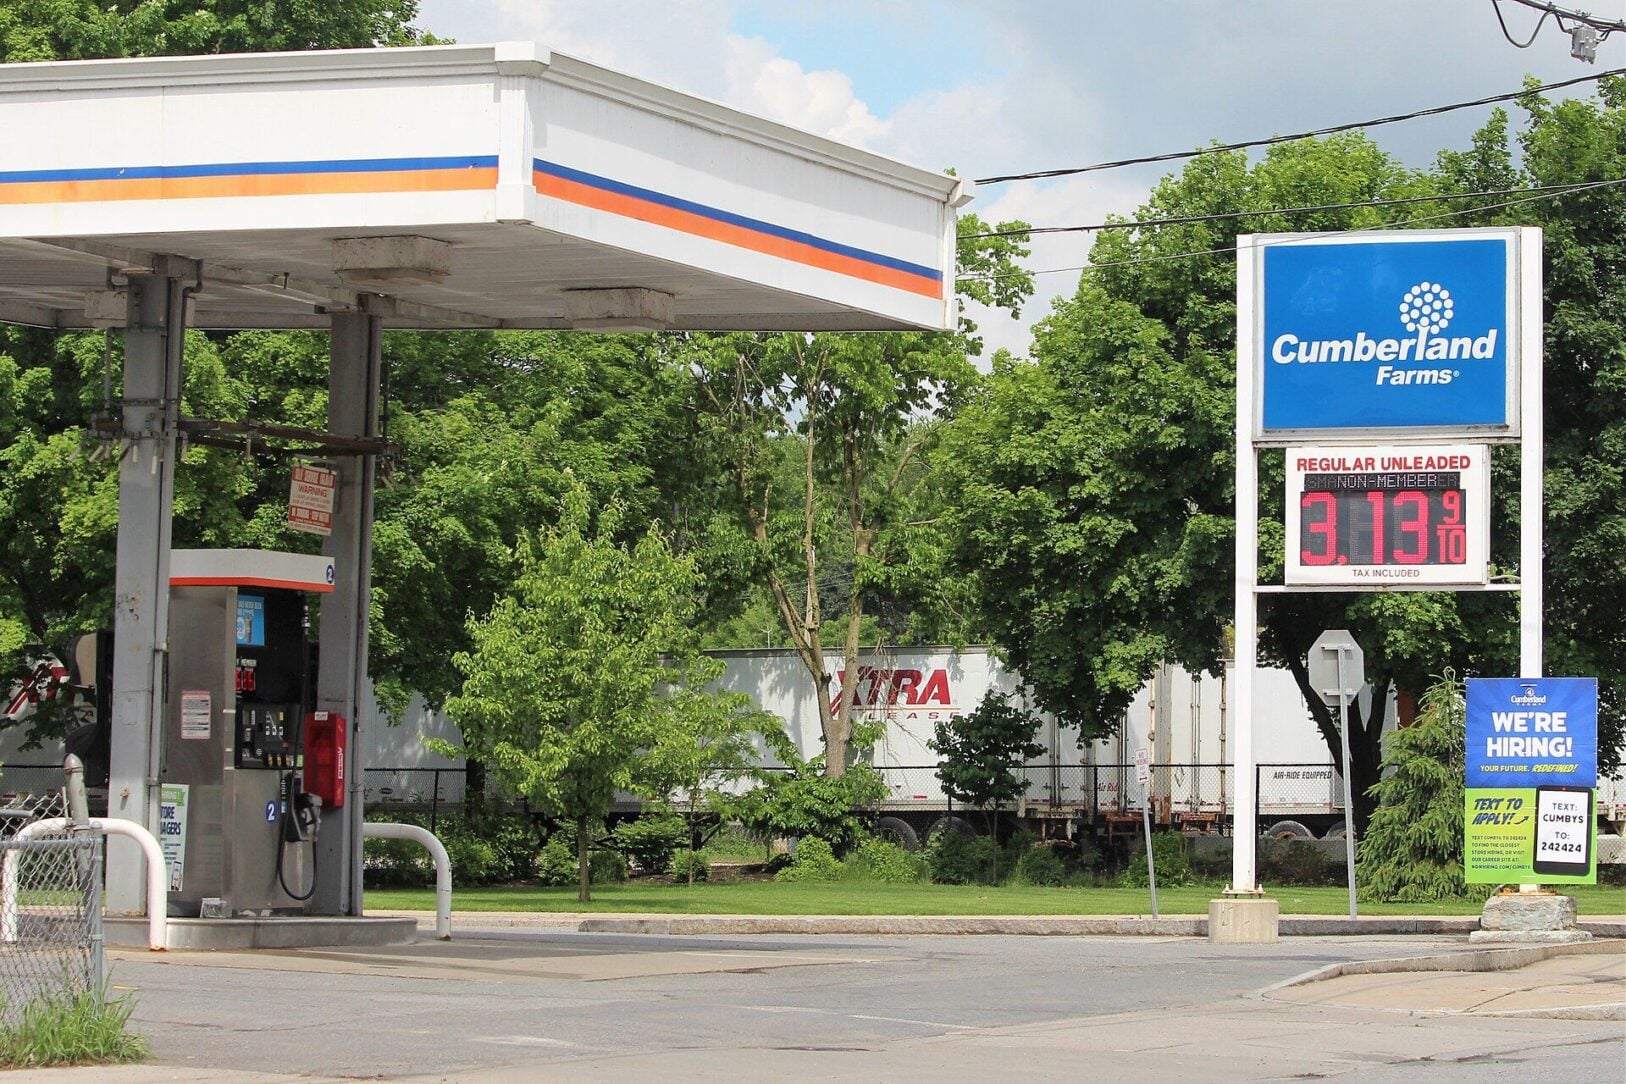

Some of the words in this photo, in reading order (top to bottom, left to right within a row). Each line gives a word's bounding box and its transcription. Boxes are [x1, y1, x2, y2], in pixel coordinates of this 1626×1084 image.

[1272, 326, 1497, 364] Cumberland
[1297, 457, 1376, 471] REGULAR
[1381, 456, 1470, 470] UNLEADED
[1337, 473, 1438, 488] NON-MEMBER
[1301, 491, 1429, 565] 3.13
[1353, 568, 1371, 577] TAX
[1372, 569, 1420, 578] INCLUDED
[1492, 711, 1567, 732] WE'RE
[1486, 736, 1573, 757] HIRING!
[1480, 764, 1500, 772] YOUR
[1501, 764, 1530, 772] FUTURE.
[1532, 763, 1579, 773] REDEFINED!
[1273, 771, 1300, 780] AIR-RIDE
[1301, 770, 1332, 779] EQUIPPED
[1474, 798, 1504, 810] TEXT
[1506, 798, 1523, 810] TO
[1552, 802, 1578, 811] TEXT:
[267, 803, 275, 820] 2
[1472, 812, 1516, 825] APPLY!
[1543, 813, 1584, 824] CUMBYS
[1554, 831, 1571, 840] TO:
[1541, 841, 1582, 853] 242424
